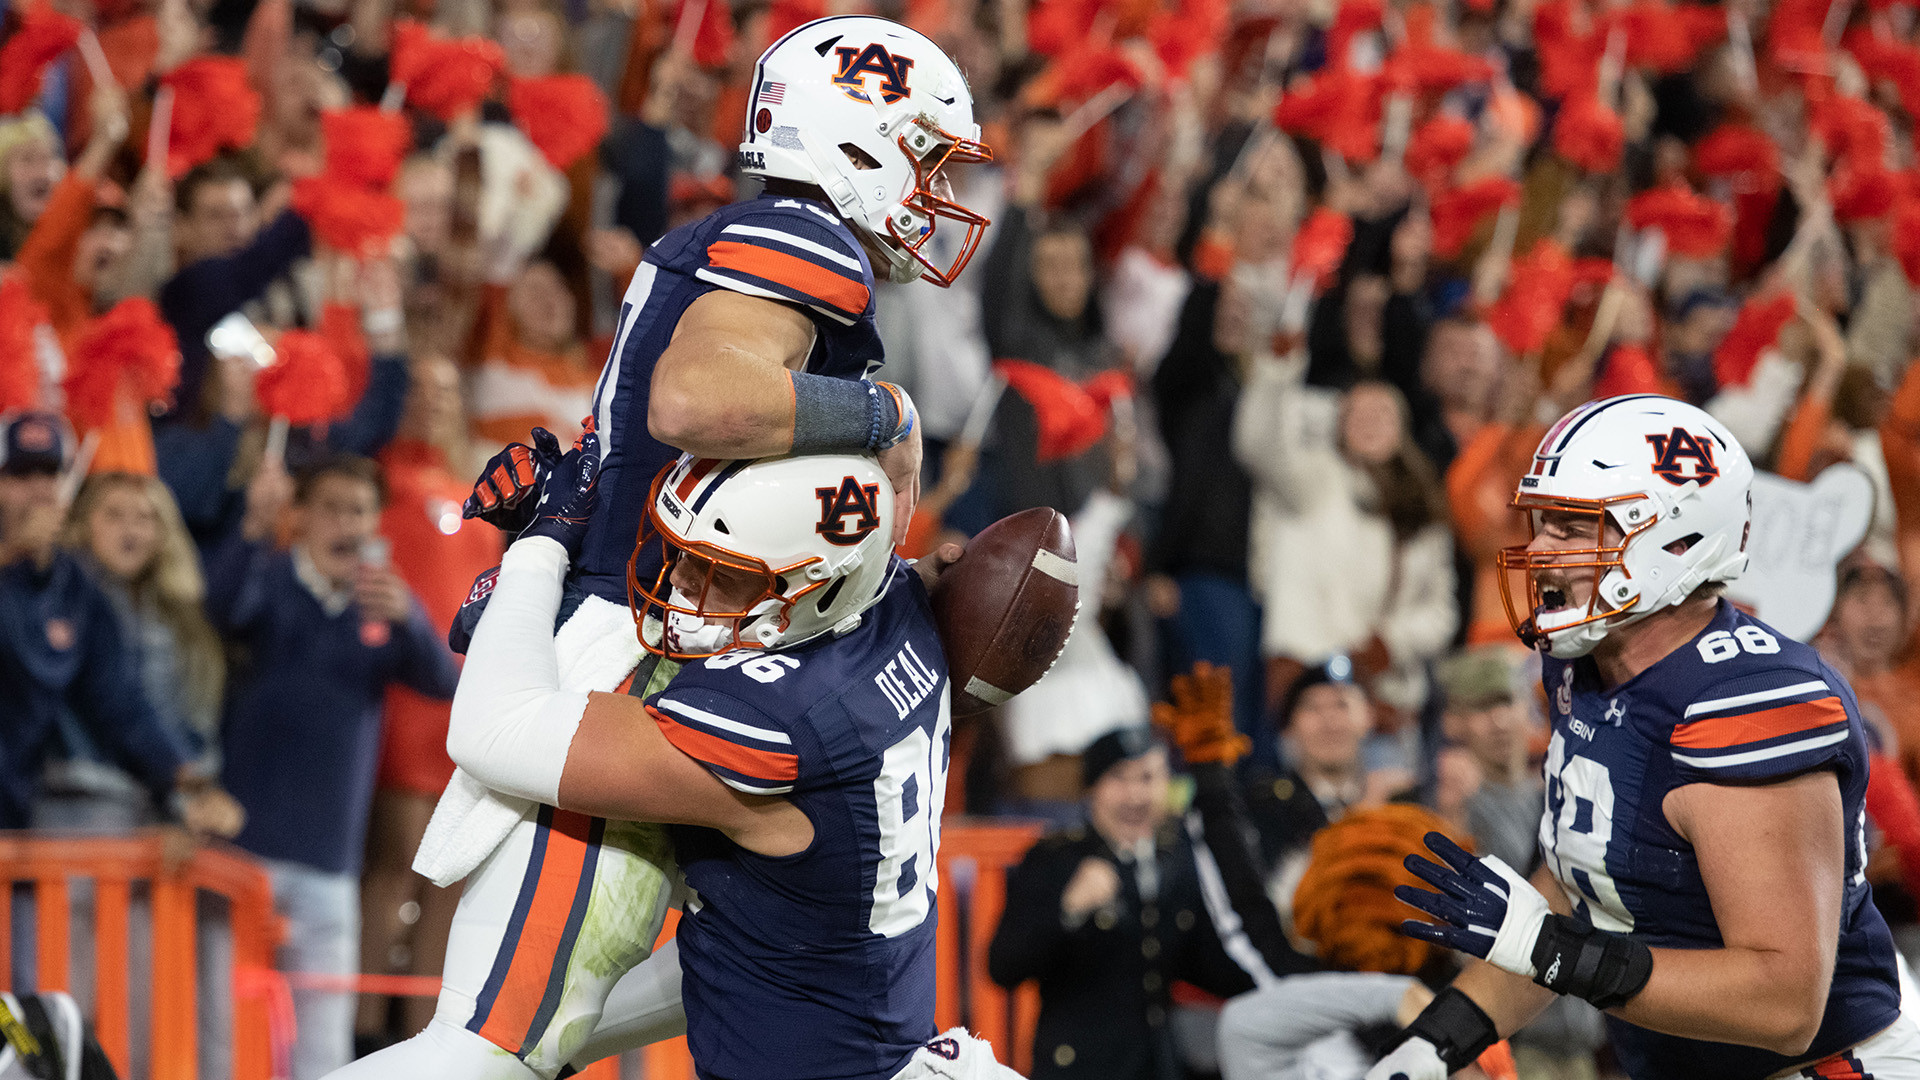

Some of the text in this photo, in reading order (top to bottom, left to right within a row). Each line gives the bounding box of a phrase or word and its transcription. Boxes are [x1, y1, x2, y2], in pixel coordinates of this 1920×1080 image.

[703, 648, 801, 683] 86
[1697, 625, 1781, 664] 68
[874, 640, 939, 721] DEAL
[1539, 729, 1635, 933] 68
